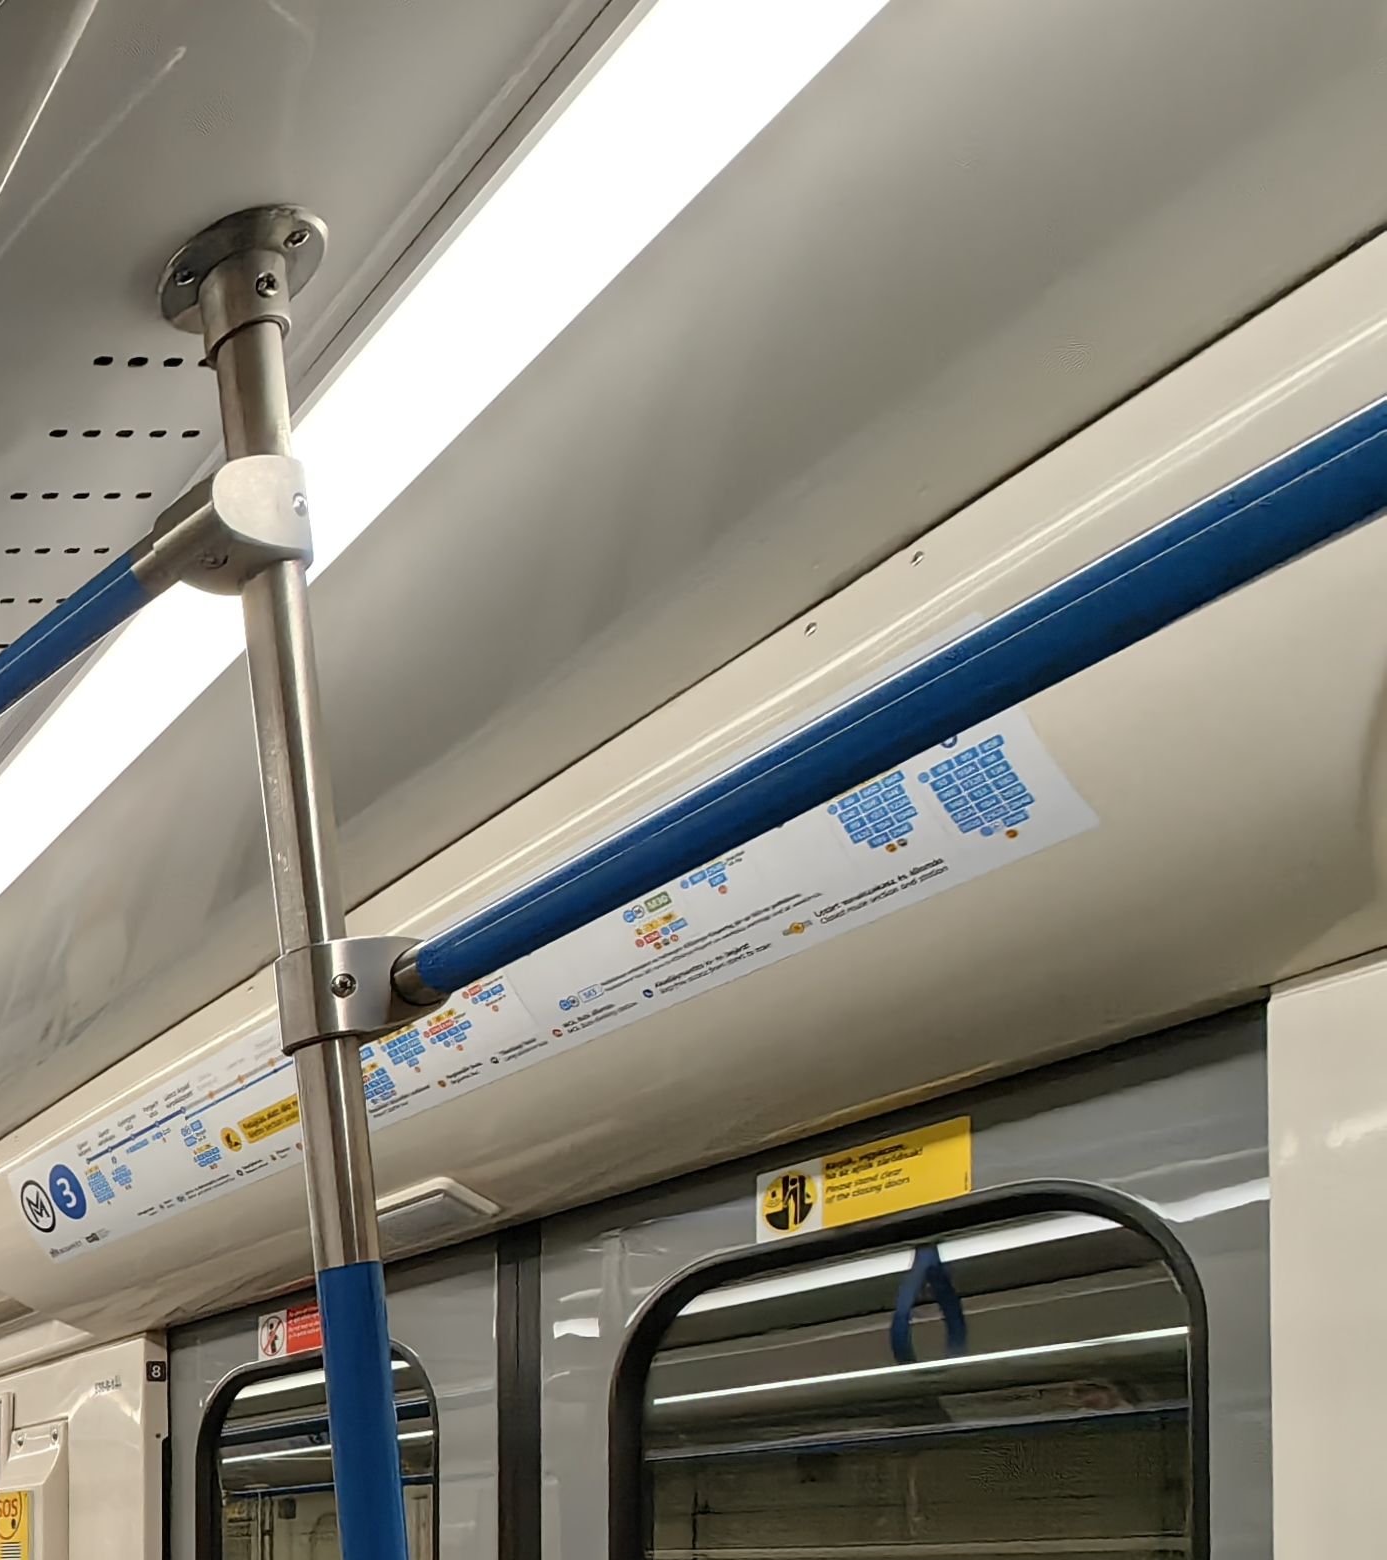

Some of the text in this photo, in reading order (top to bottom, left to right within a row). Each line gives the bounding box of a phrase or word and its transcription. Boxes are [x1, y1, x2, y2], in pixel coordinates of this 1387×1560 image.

[25, 1190, 51, 1224] M
[56, 1177, 77, 1209] 3
[852, 1184, 882, 1197] closing
